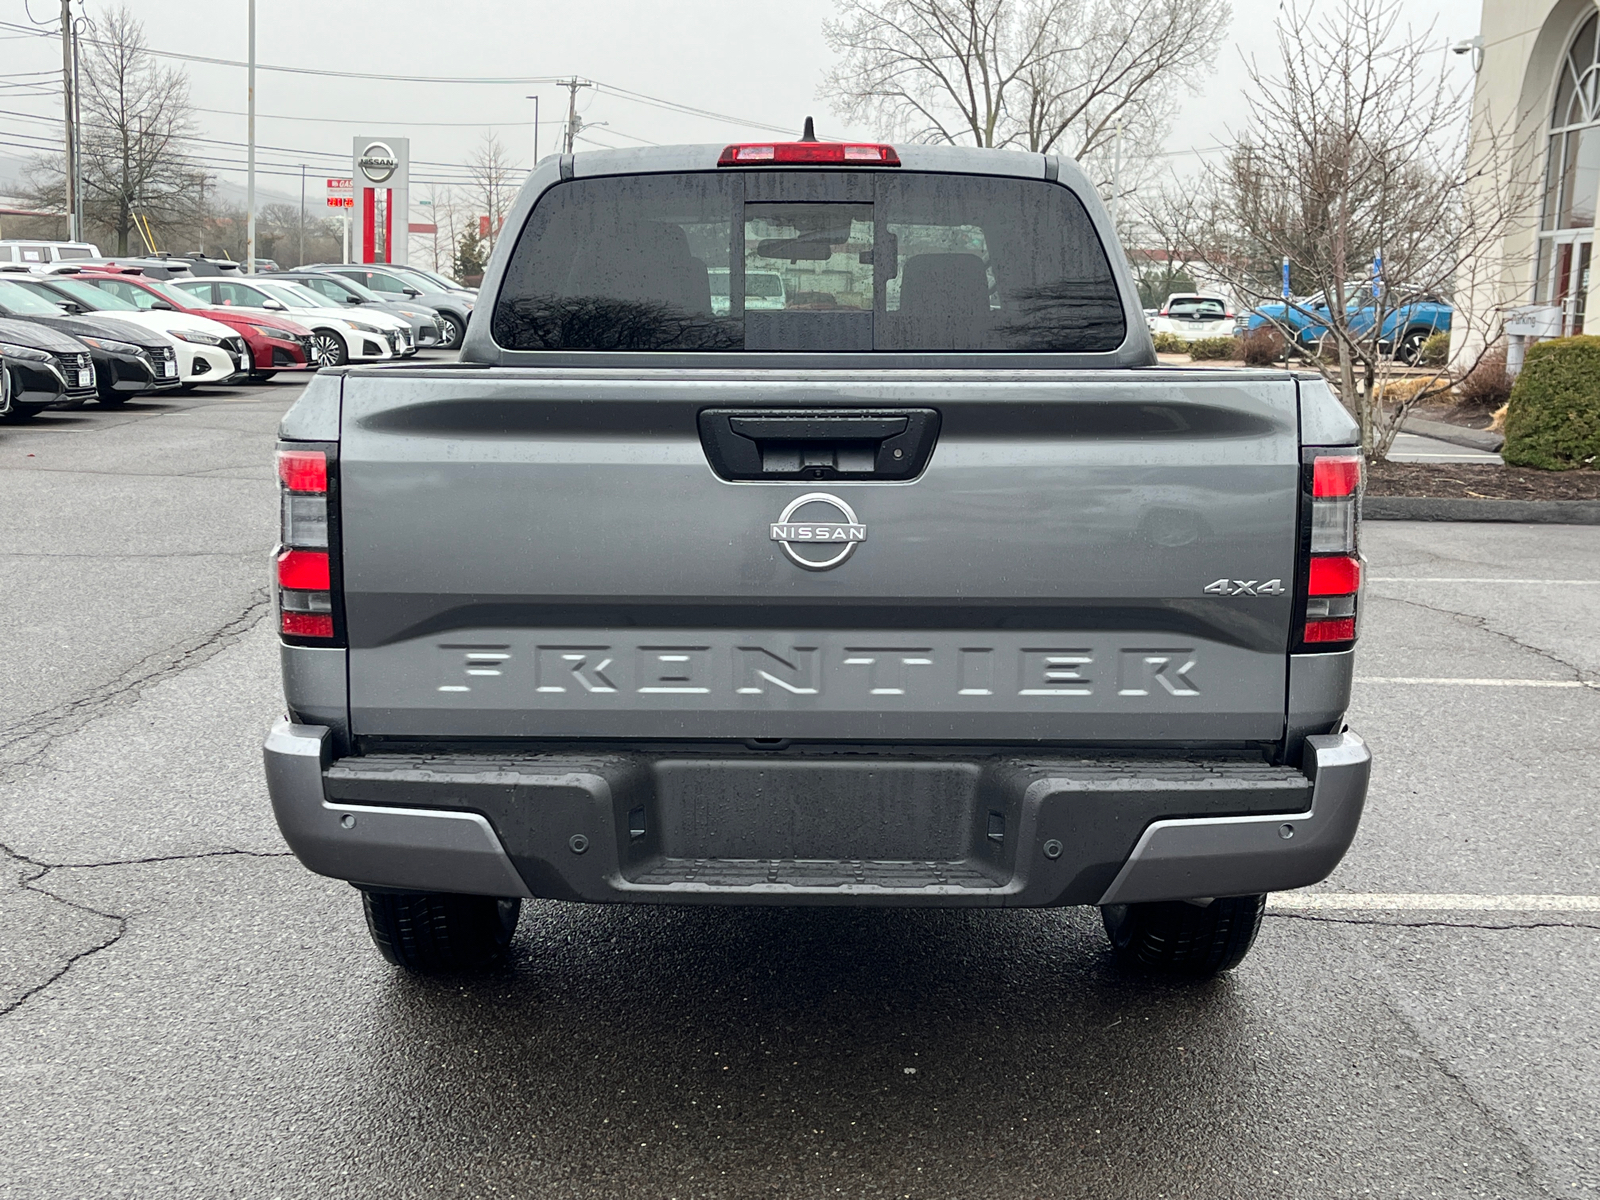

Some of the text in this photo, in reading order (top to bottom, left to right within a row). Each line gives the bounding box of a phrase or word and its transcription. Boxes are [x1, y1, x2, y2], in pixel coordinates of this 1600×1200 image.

[360, 158, 394, 166] NISSAN
[772, 526, 865, 540] NISSAN
[437, 643, 1201, 696] FRONTIER
